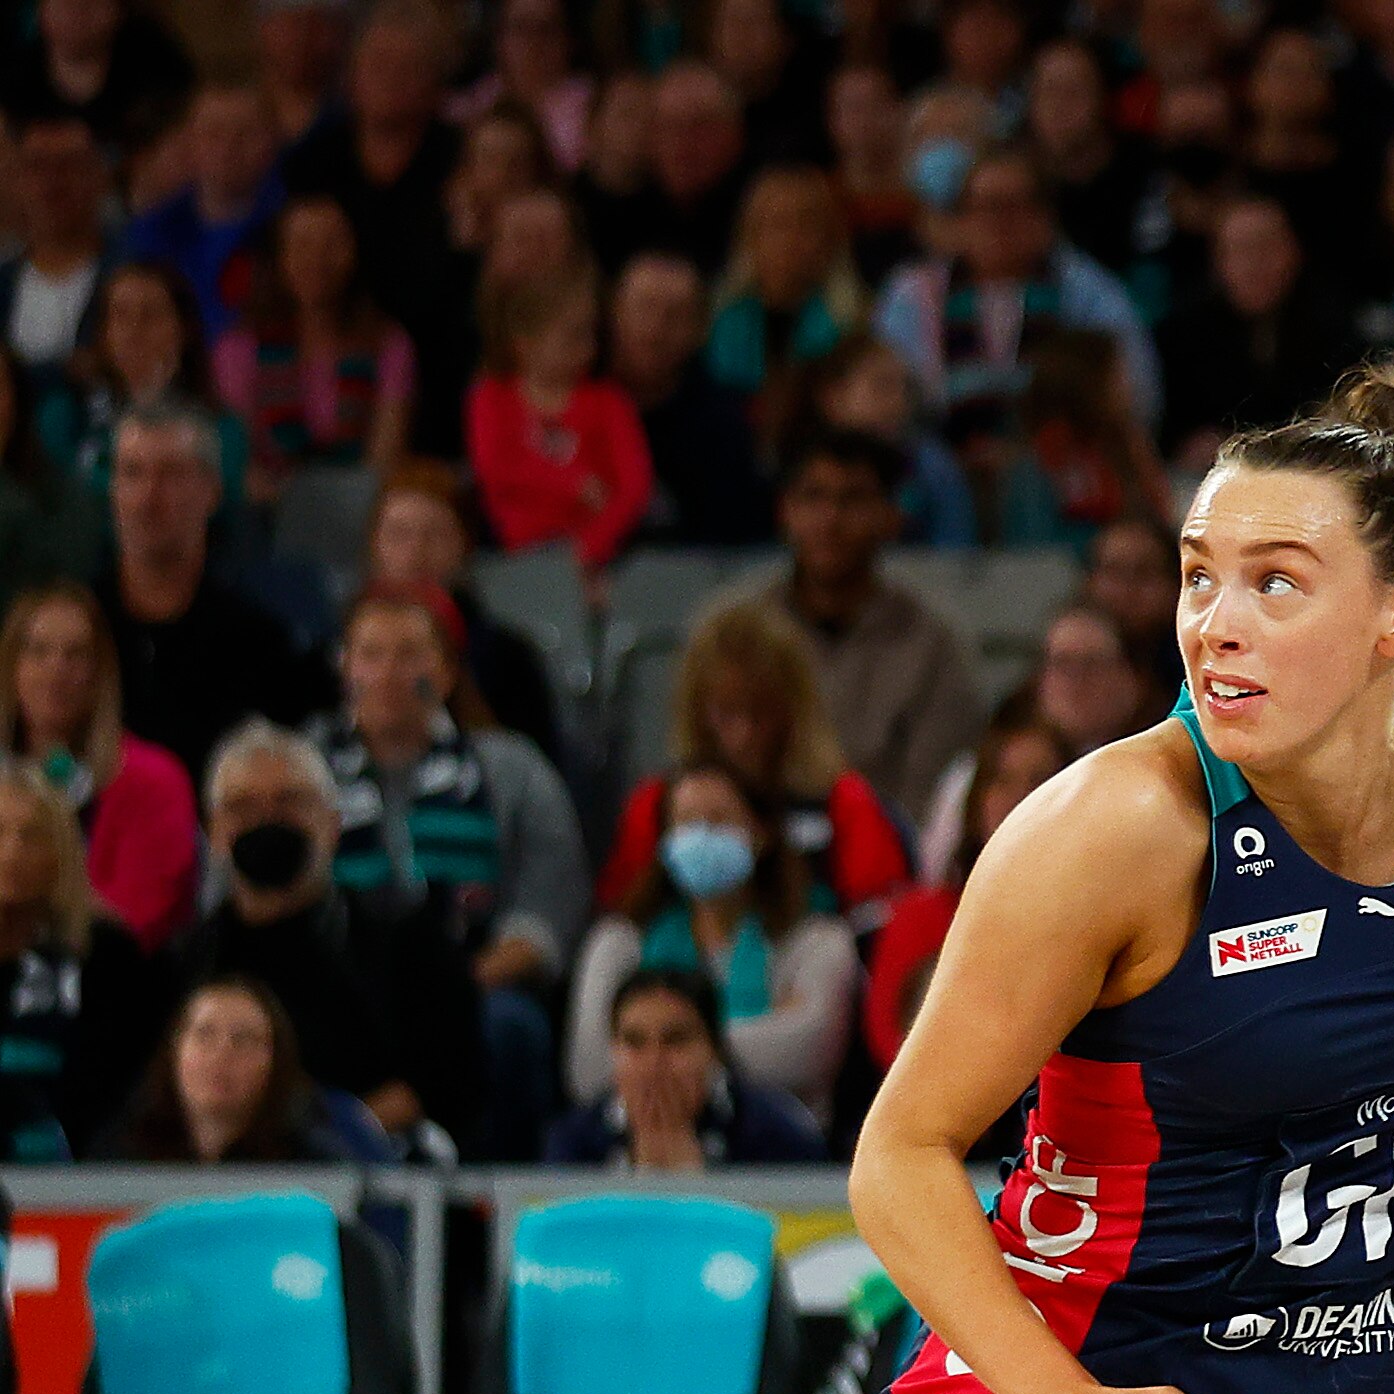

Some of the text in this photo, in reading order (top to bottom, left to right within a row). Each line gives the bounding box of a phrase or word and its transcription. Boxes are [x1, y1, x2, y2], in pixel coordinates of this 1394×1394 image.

[1235, 858, 1275, 877] origin
[1247, 923, 1299, 942] SUNCORP
[1248, 935, 1288, 951] SUPER
[1250, 943, 1304, 962] NETBALL
